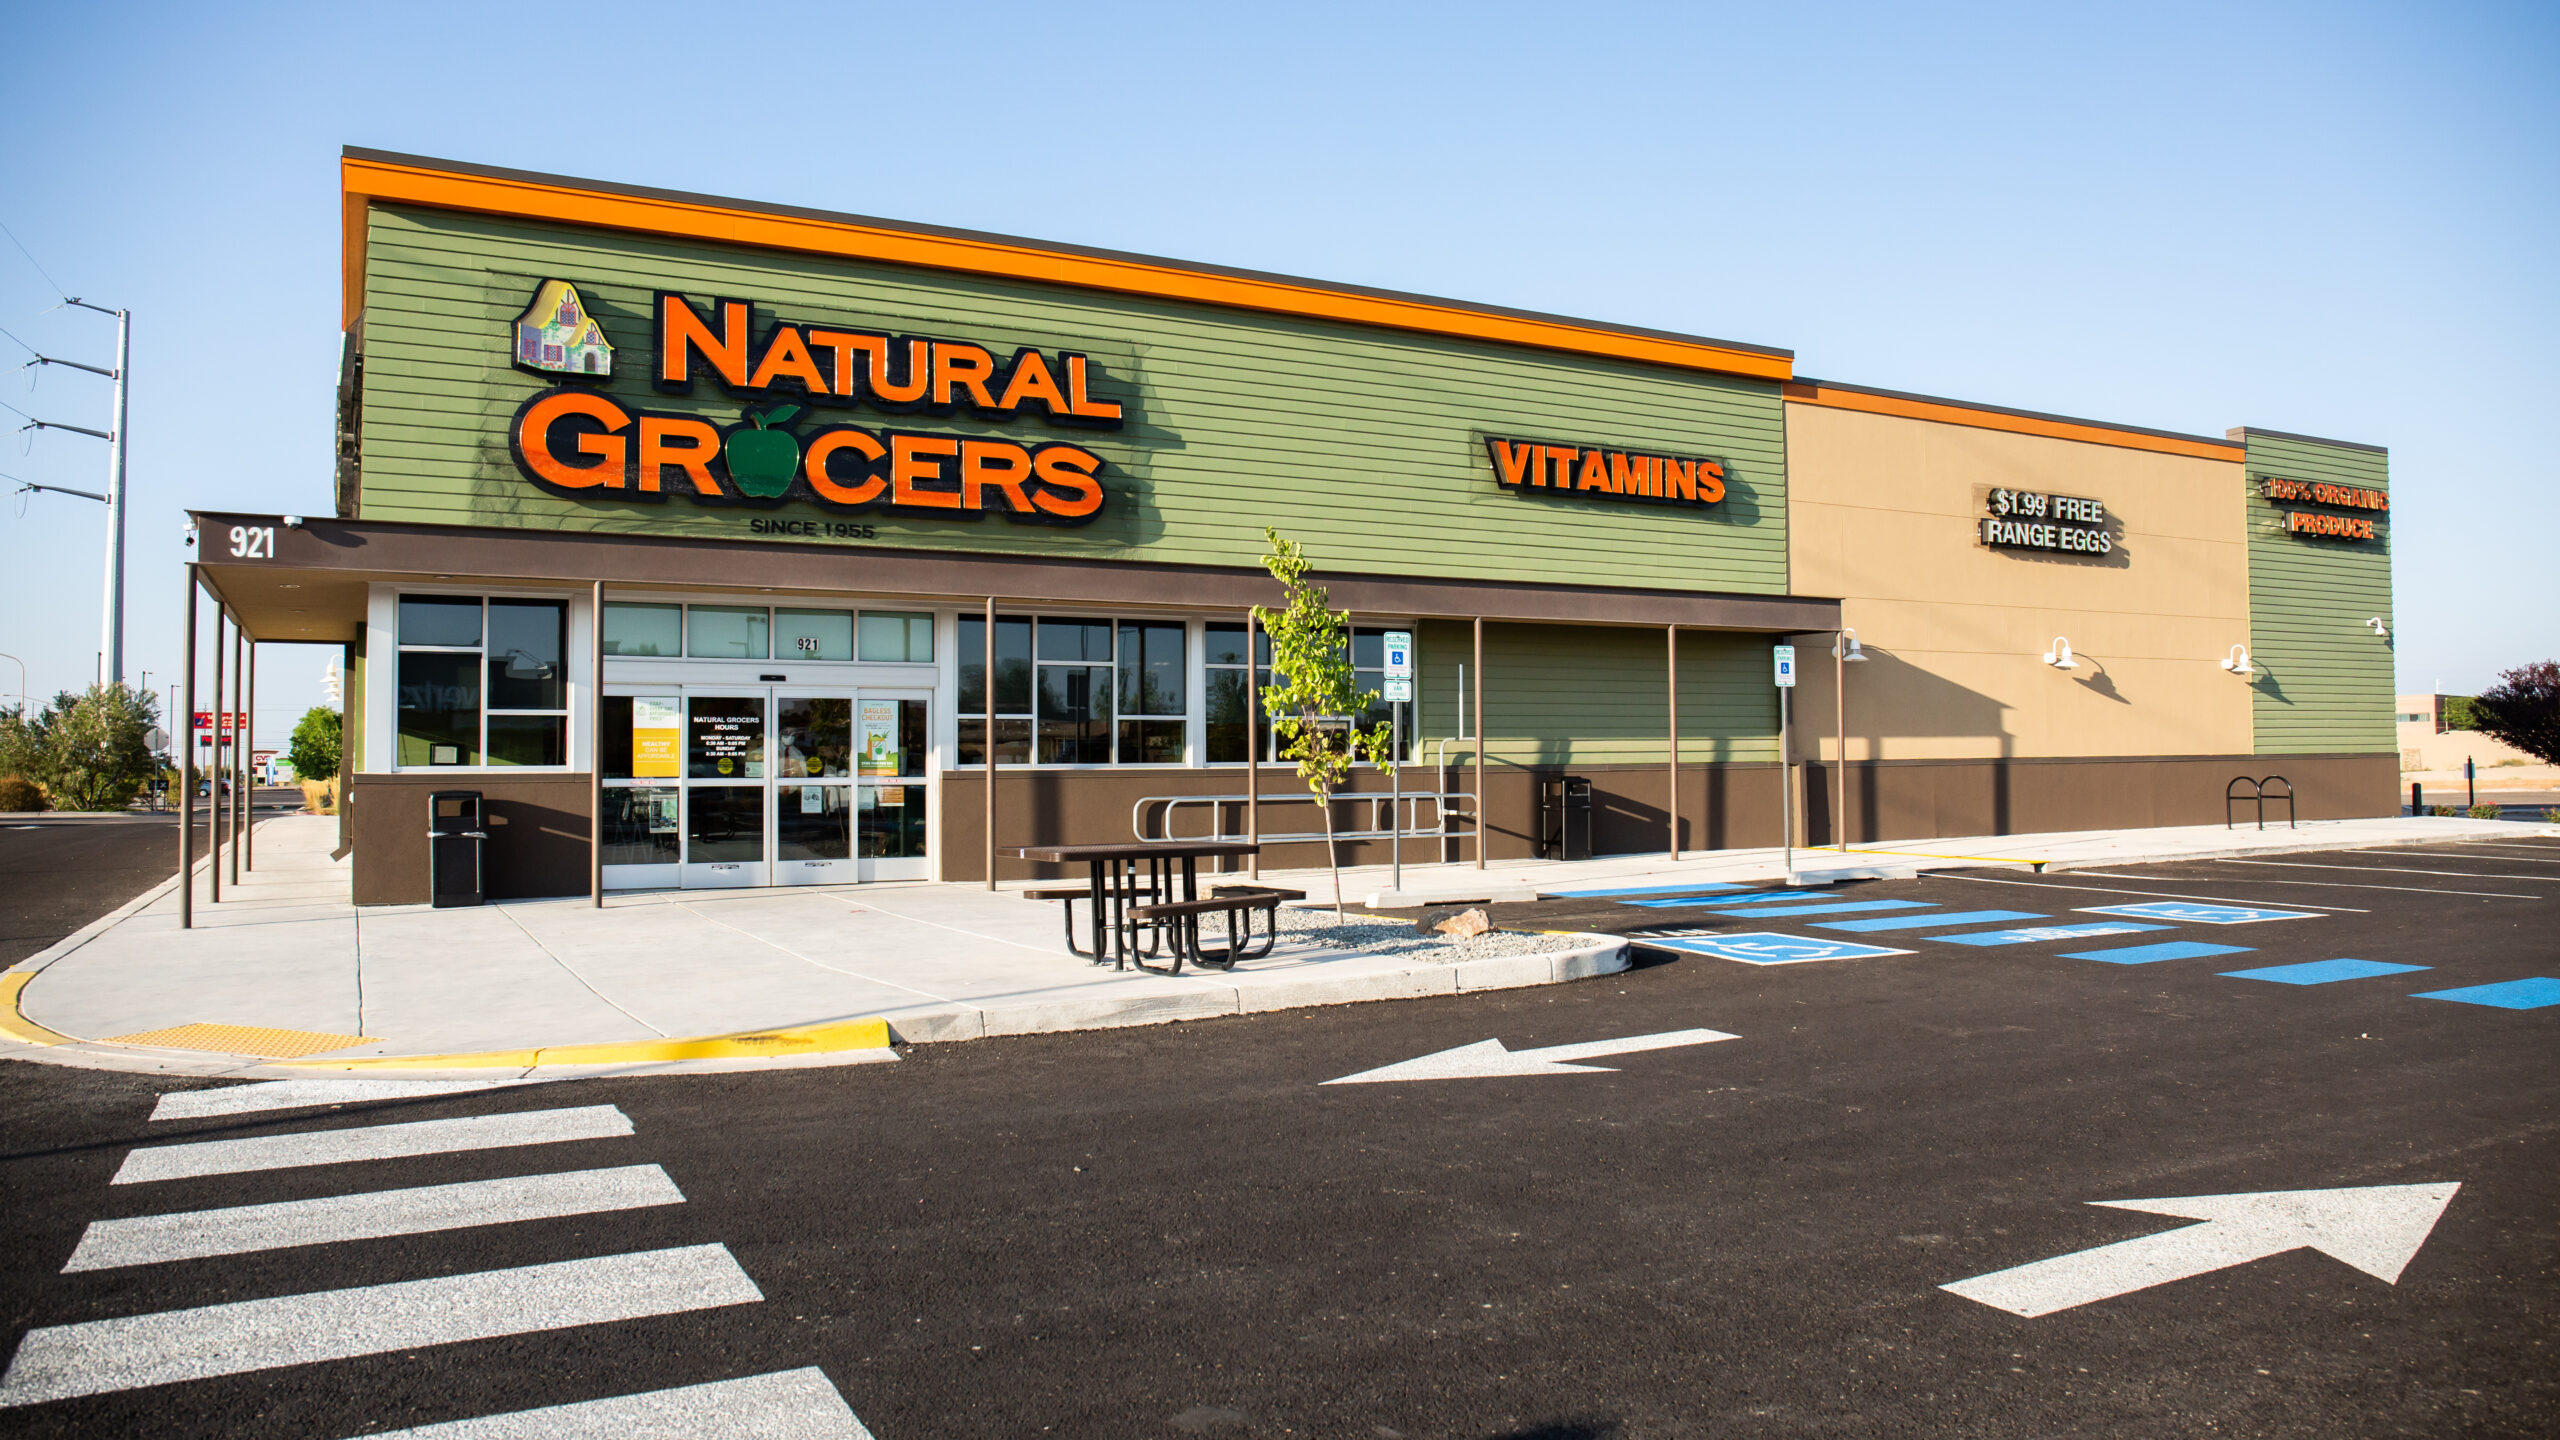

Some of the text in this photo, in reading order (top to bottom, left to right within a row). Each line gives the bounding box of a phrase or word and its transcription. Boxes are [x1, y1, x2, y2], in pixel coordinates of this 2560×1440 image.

[1495, 440, 1725, 505] VITAMINS
[1997, 488, 2103, 523] $1.99 FREE
[2267, 478, 2389, 511] 100% ORGANIC
[750, 519, 877, 539] SINCE 1955
[1987, 520, 2112, 553] RANGE EGGS
[2291, 512, 2374, 539] PRODUCE
[229, 526, 274, 559] 921
[797, 638, 819, 651] 921
[1387, 643, 1408, 651] PARKING
